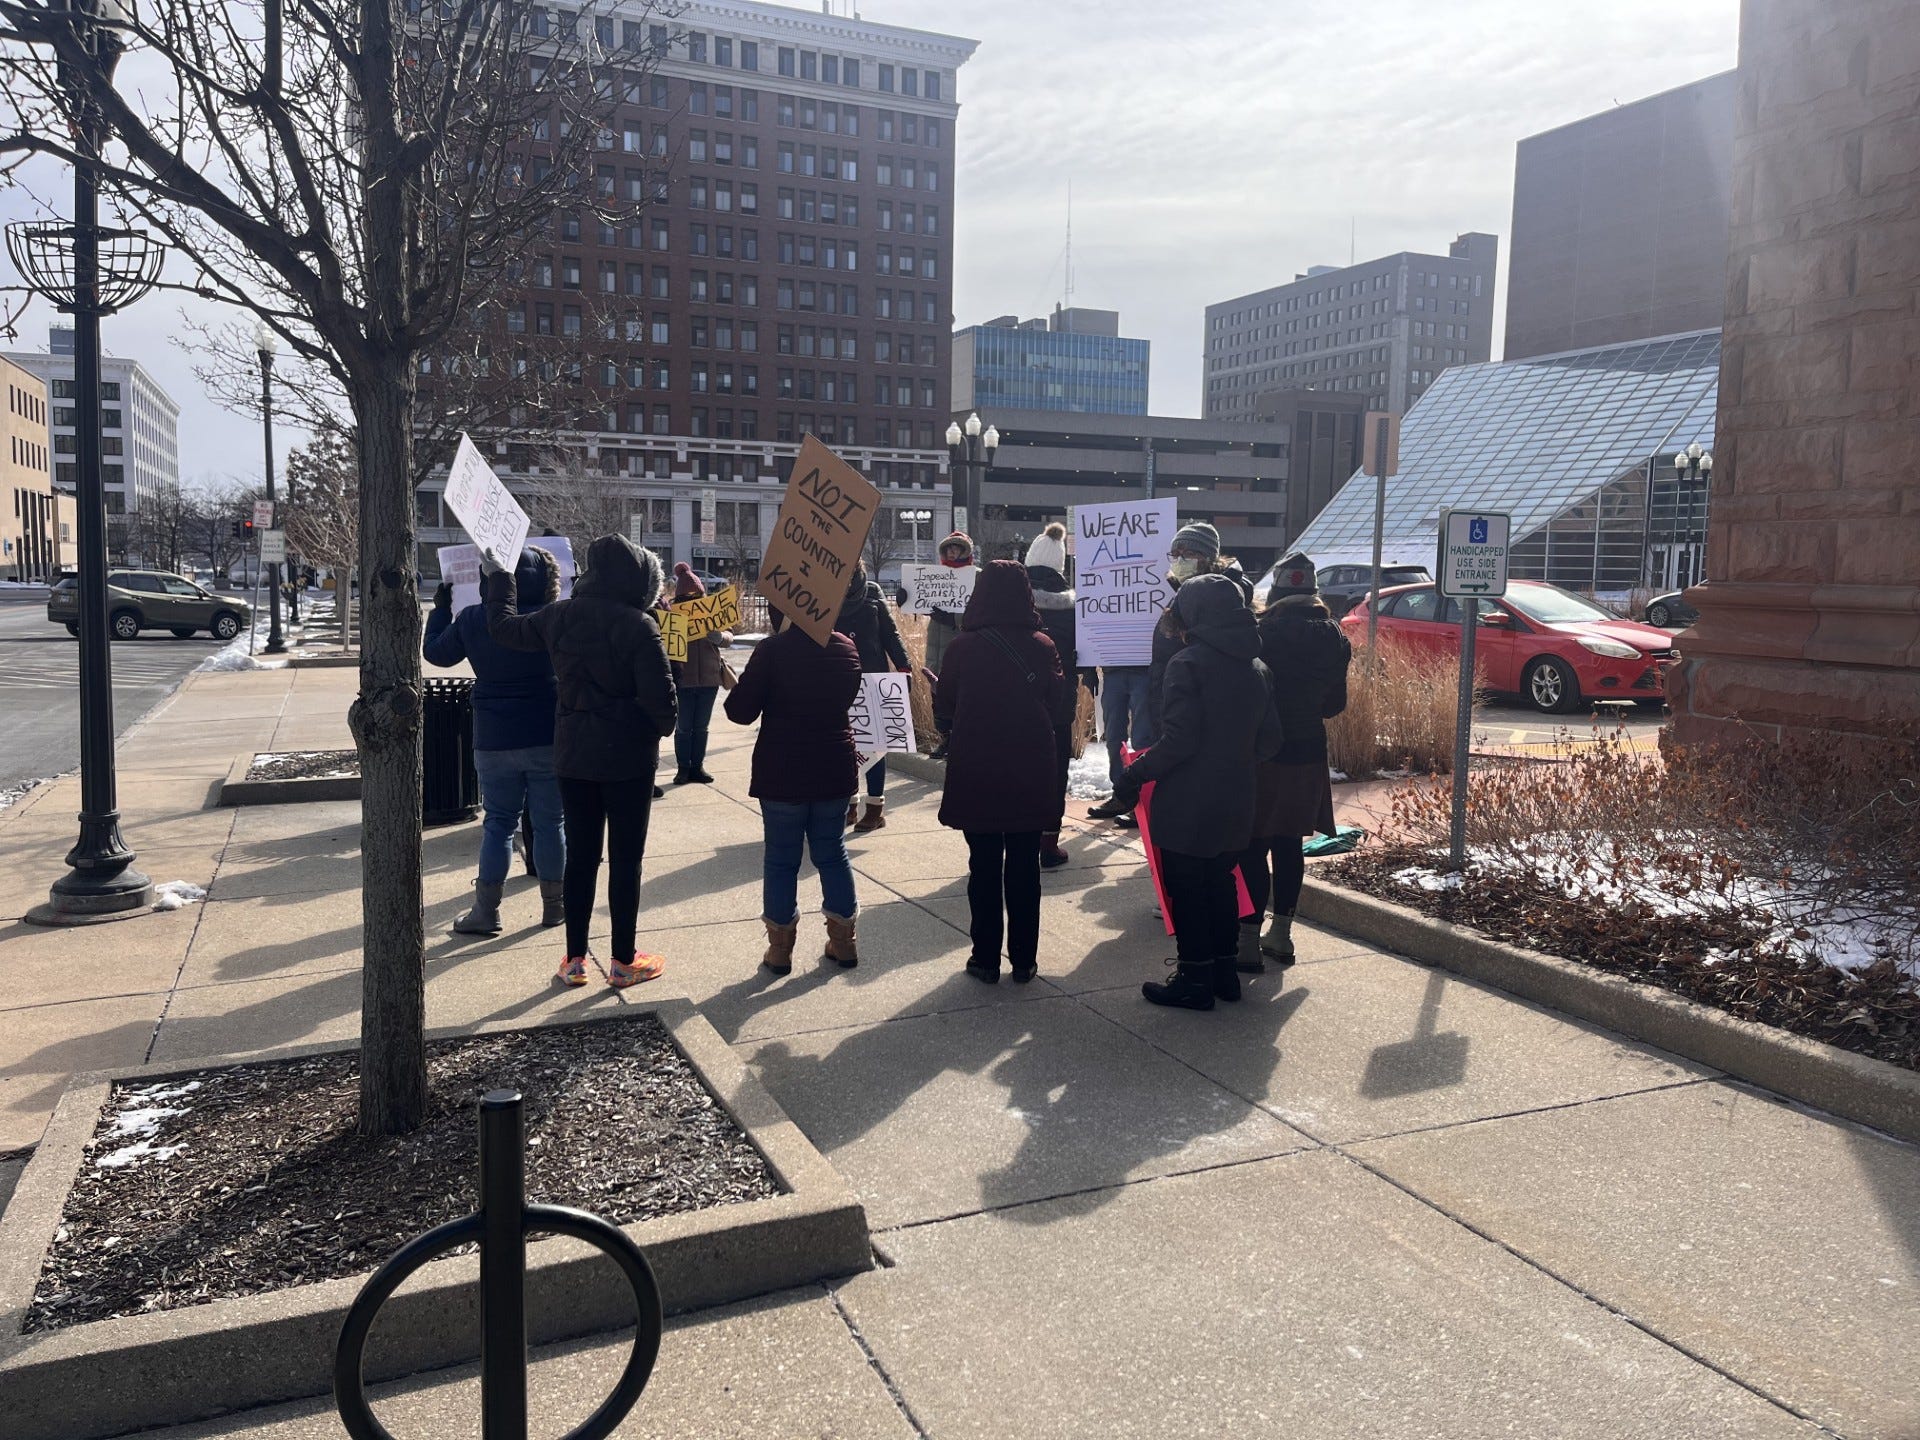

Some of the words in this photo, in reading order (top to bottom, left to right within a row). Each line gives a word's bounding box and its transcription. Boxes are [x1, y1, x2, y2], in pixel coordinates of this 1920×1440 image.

[798, 467, 867, 520] NOT
[495, 503, 522, 563] RUELTY
[810, 510, 833, 536] THE
[783, 516, 847, 580] COUNTRY
[1091, 536, 1144, 566] ALL
[1450, 545, 1505, 557] HANDICAPPED
[1457, 557, 1474, 568] USE
[1478, 558, 1497, 568] SIDE
[799, 560, 811, 577] I
[1110, 564, 1161, 588] THIS
[1455, 569, 1497, 580] ENTRANCE
[679, 588, 732, 617] SAVE
[765, 564, 831, 622] KNOW
[687, 600, 739, 637] EMOCRACY
[878, 677, 909, 752] SUPPORT
